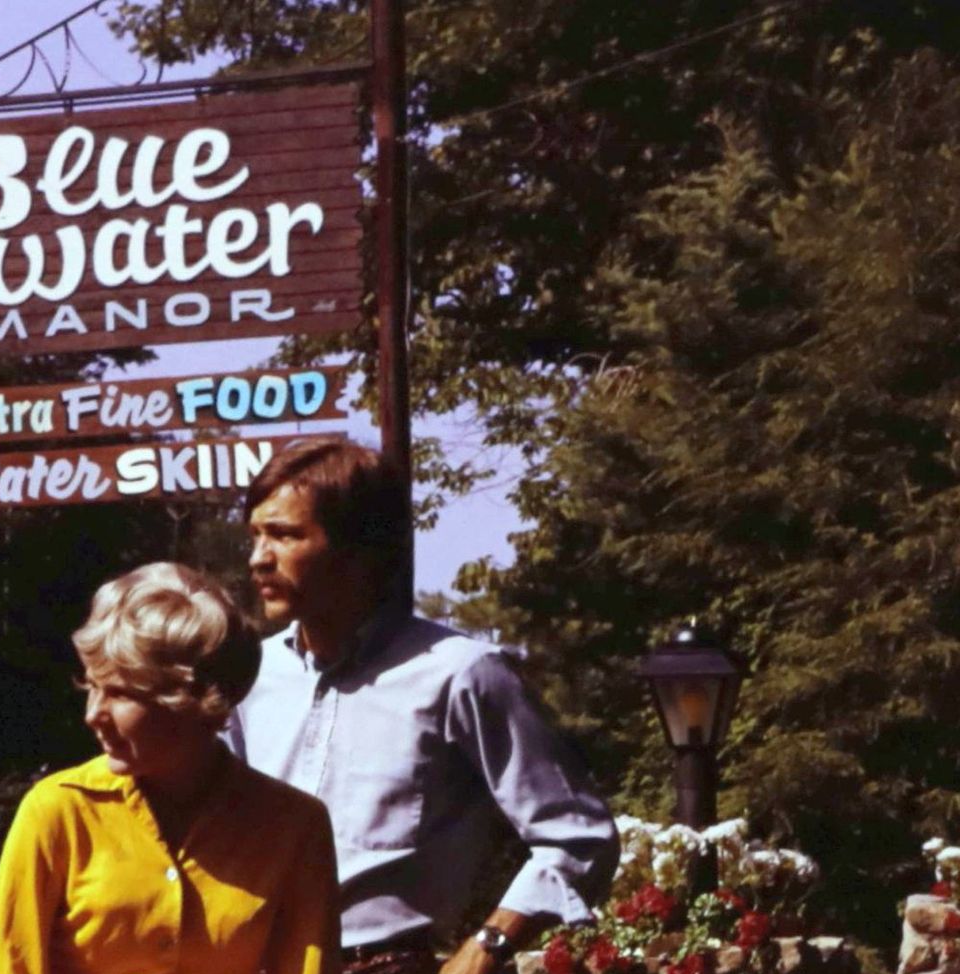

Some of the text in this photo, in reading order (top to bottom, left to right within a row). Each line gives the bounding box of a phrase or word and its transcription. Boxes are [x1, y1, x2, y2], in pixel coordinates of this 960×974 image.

[61, 384, 172, 431] Fine
[176, 371, 327, 422] FOOD
[116, 440, 303, 495] SKIIN
